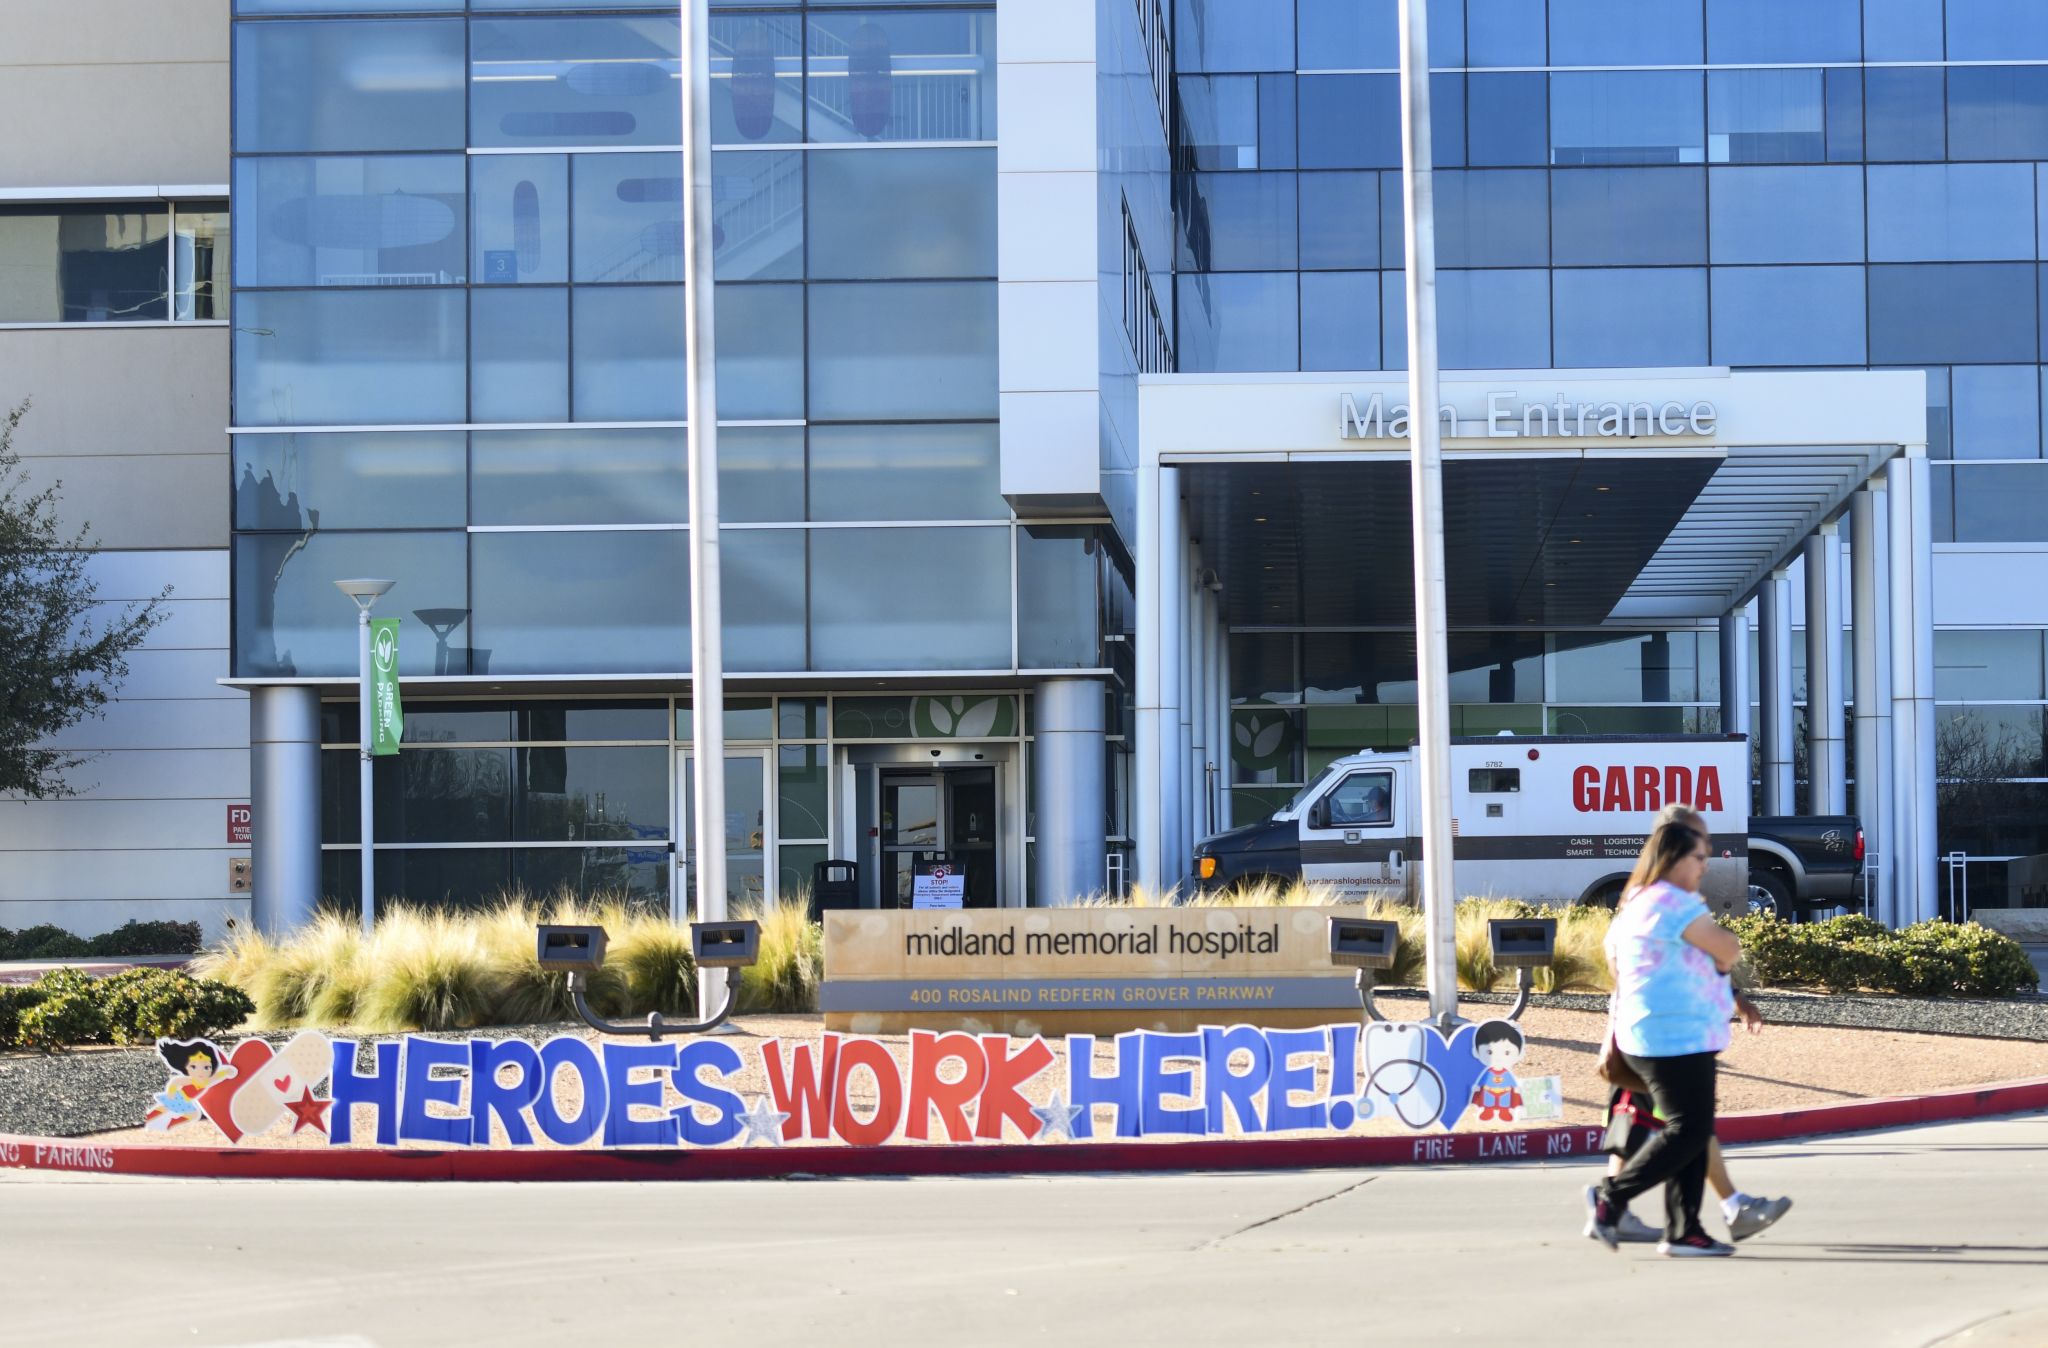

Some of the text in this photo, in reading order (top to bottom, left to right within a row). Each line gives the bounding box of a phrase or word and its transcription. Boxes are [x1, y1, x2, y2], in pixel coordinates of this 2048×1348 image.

[497, 259, 505, 271] 3
[1340, 390, 1717, 439] Man Entrance
[384, 682, 394, 728] GREEN
[1572, 765, 1723, 813] GARDA
[231, 809, 251, 823] FD
[233, 826, 252, 834] PATIE
[234, 833, 252, 841] TOW
[1603, 837, 1647, 845] LOGISTICS.
[1604, 848, 1643, 856] TECHNOL
[906, 923, 1279, 959] midland memorial hospital
[910, 985, 1275, 1003] 400 ROSALIND REDFERN GROVER PARKWAY
[330, 1022, 1361, 1148] HEROES WORK HERE!
[0, 1143, 114, 1168] NO PARKING
[1413, 1138, 1455, 1160] FIRE
[1479, 1134, 1528, 1157] LANE
[1547, 1132, 1572, 1154] NO
